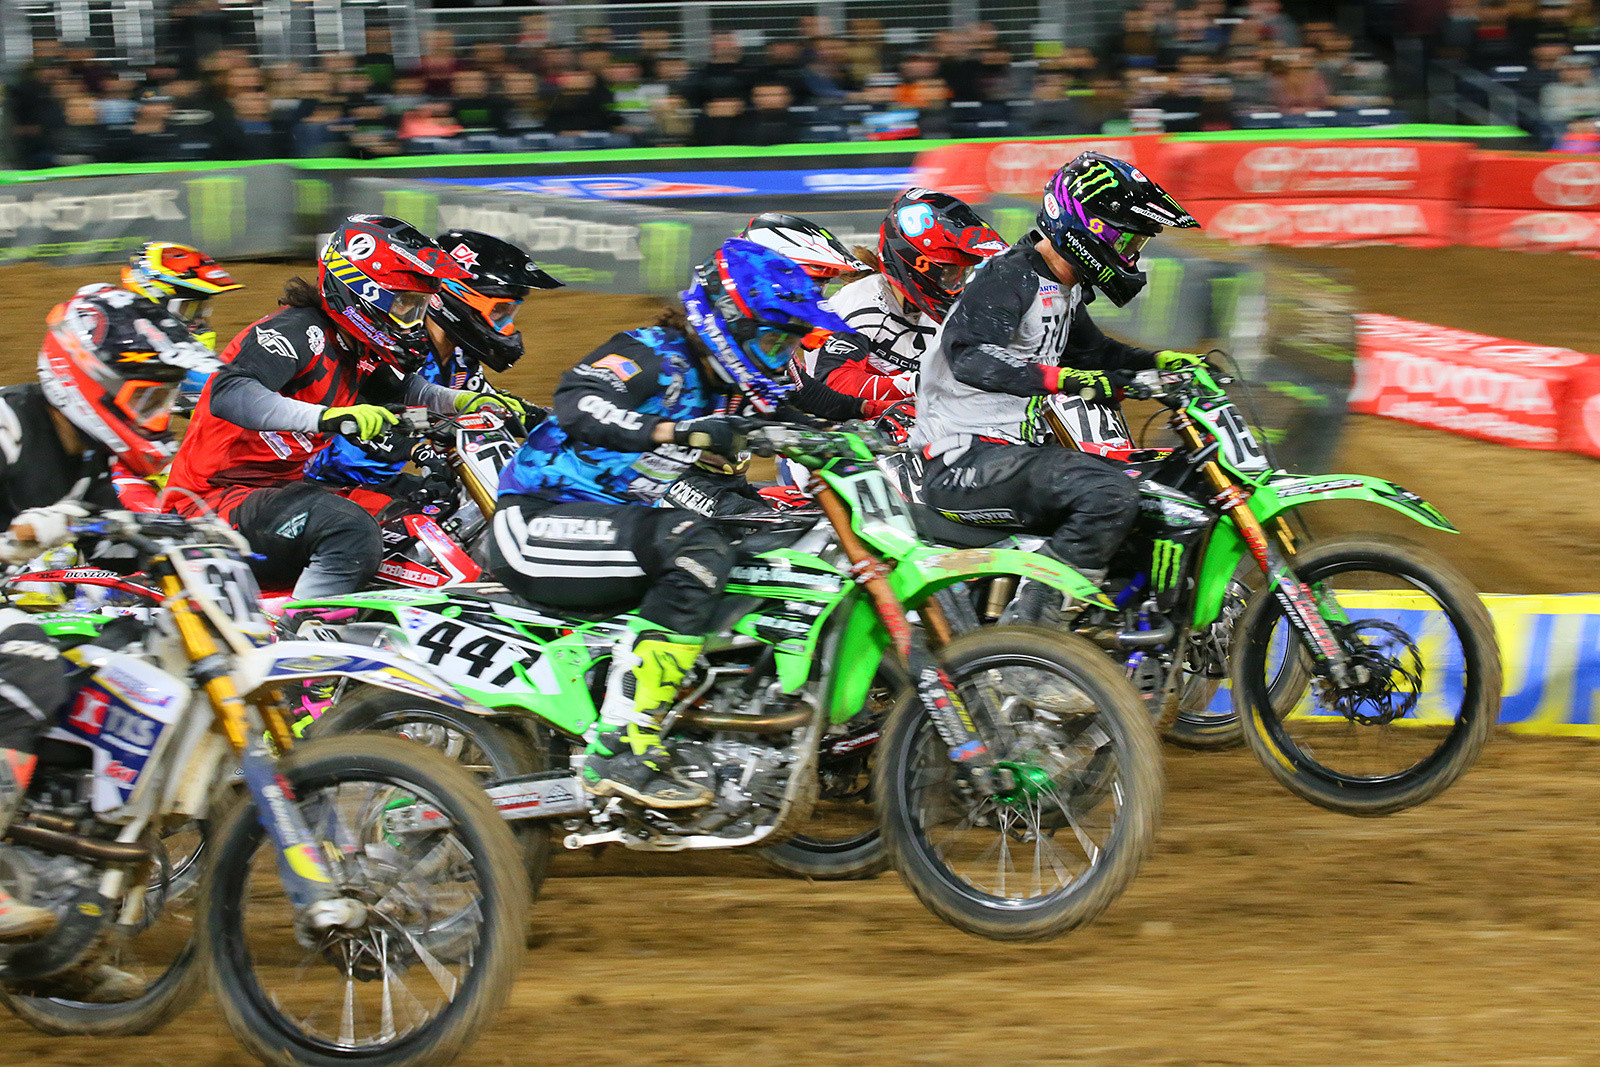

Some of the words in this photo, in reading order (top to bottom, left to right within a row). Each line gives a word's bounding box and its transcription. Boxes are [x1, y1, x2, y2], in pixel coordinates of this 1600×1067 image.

[1065, 231, 1103, 271] MONSTER
[876, 349, 919, 369] RACIN
[64, 571, 118, 579] DUNLOP
[378, 563, 440, 586] UCEDEUCE.COM
[417, 620, 543, 688] 447
